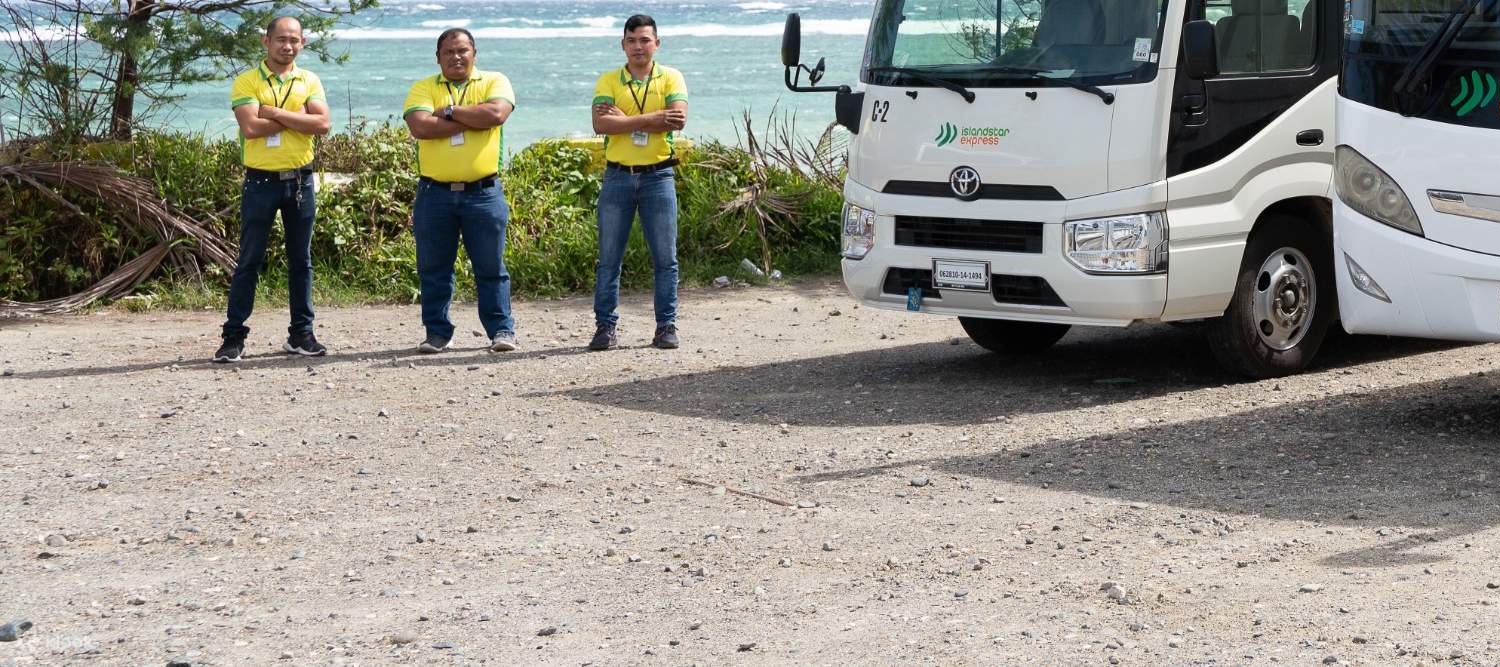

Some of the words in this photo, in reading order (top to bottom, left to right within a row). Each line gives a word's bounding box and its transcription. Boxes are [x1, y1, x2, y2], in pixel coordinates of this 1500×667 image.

[871, 100, 890, 122] C-2
[960, 126, 1010, 137] islandstar
[960, 136, 999, 146] express
